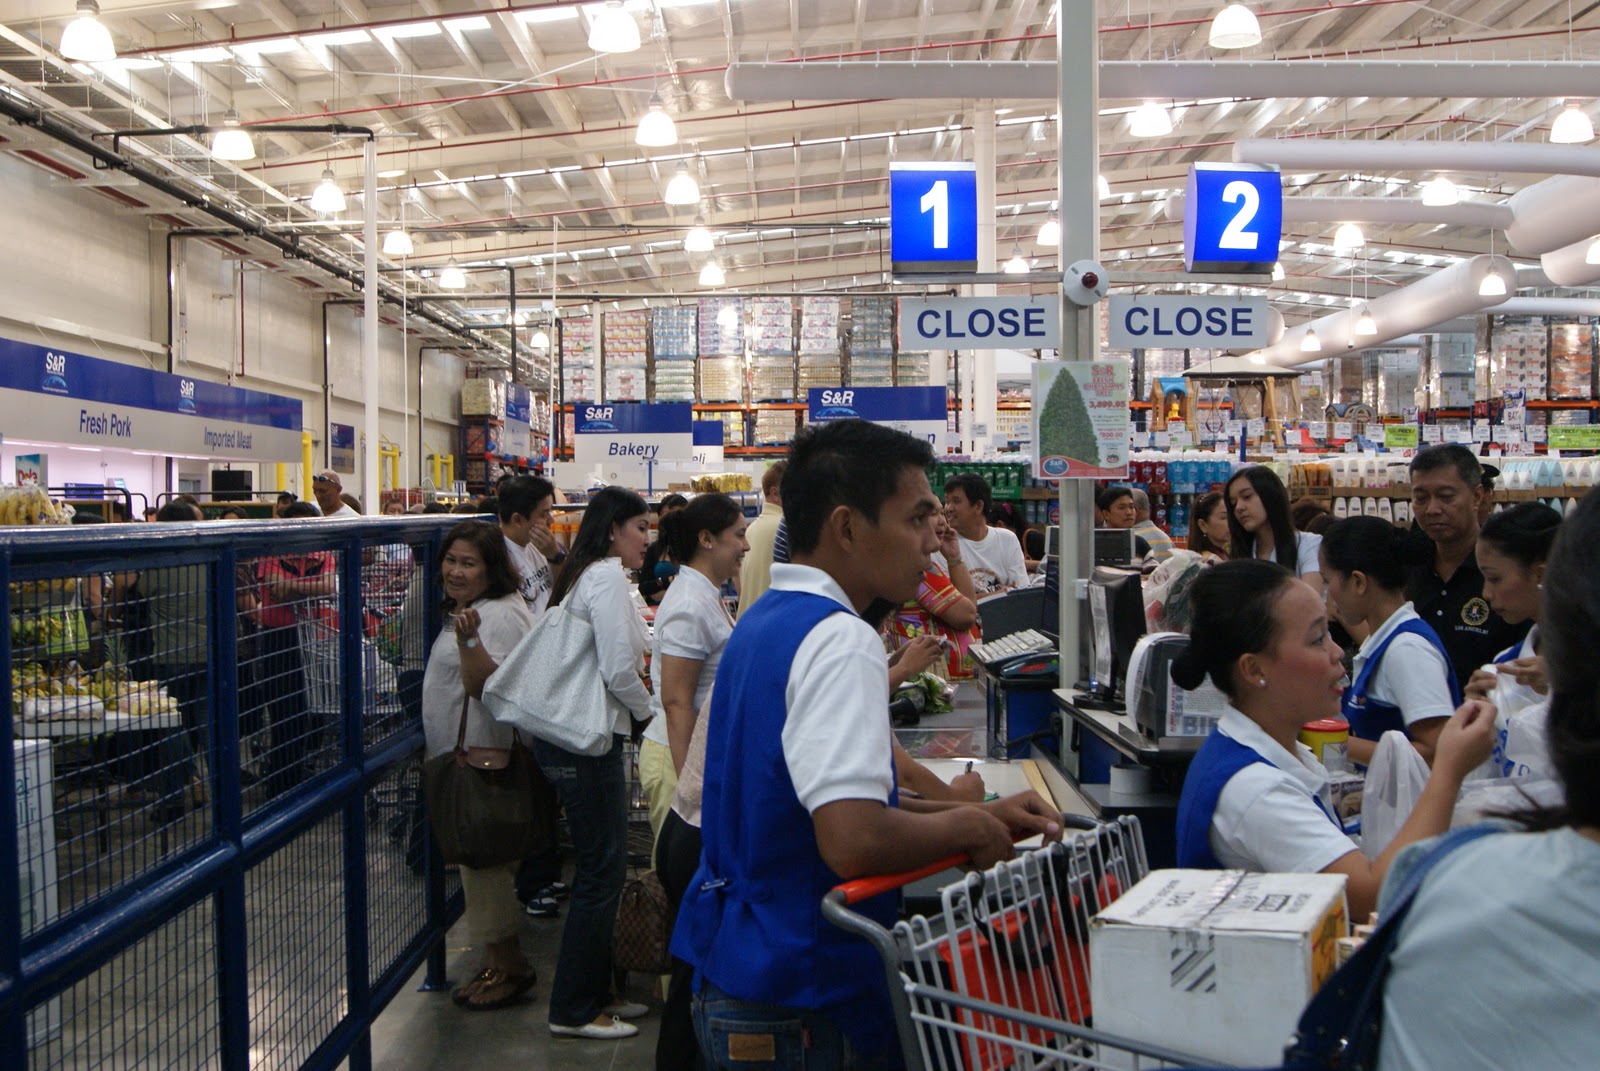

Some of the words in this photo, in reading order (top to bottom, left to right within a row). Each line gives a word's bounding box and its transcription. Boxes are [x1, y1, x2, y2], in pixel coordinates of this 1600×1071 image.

[920, 180, 949, 249] 1
[1218, 180, 1260, 250] 2
[916, 308, 1046, 339] CLOSE
[1124, 306, 1253, 336] CLOSE
[45, 352, 66, 372] S&R
[180, 379, 195, 396] S&R
[820, 390, 855, 404] S&R
[80, 409, 107, 435] Fresh
[110, 413, 132, 437] Pork
[584, 407, 614, 419] S&R
[204, 426, 235, 451] Imported
[237, 431, 252, 449] Meat
[608, 442, 660, 459] Bakery
